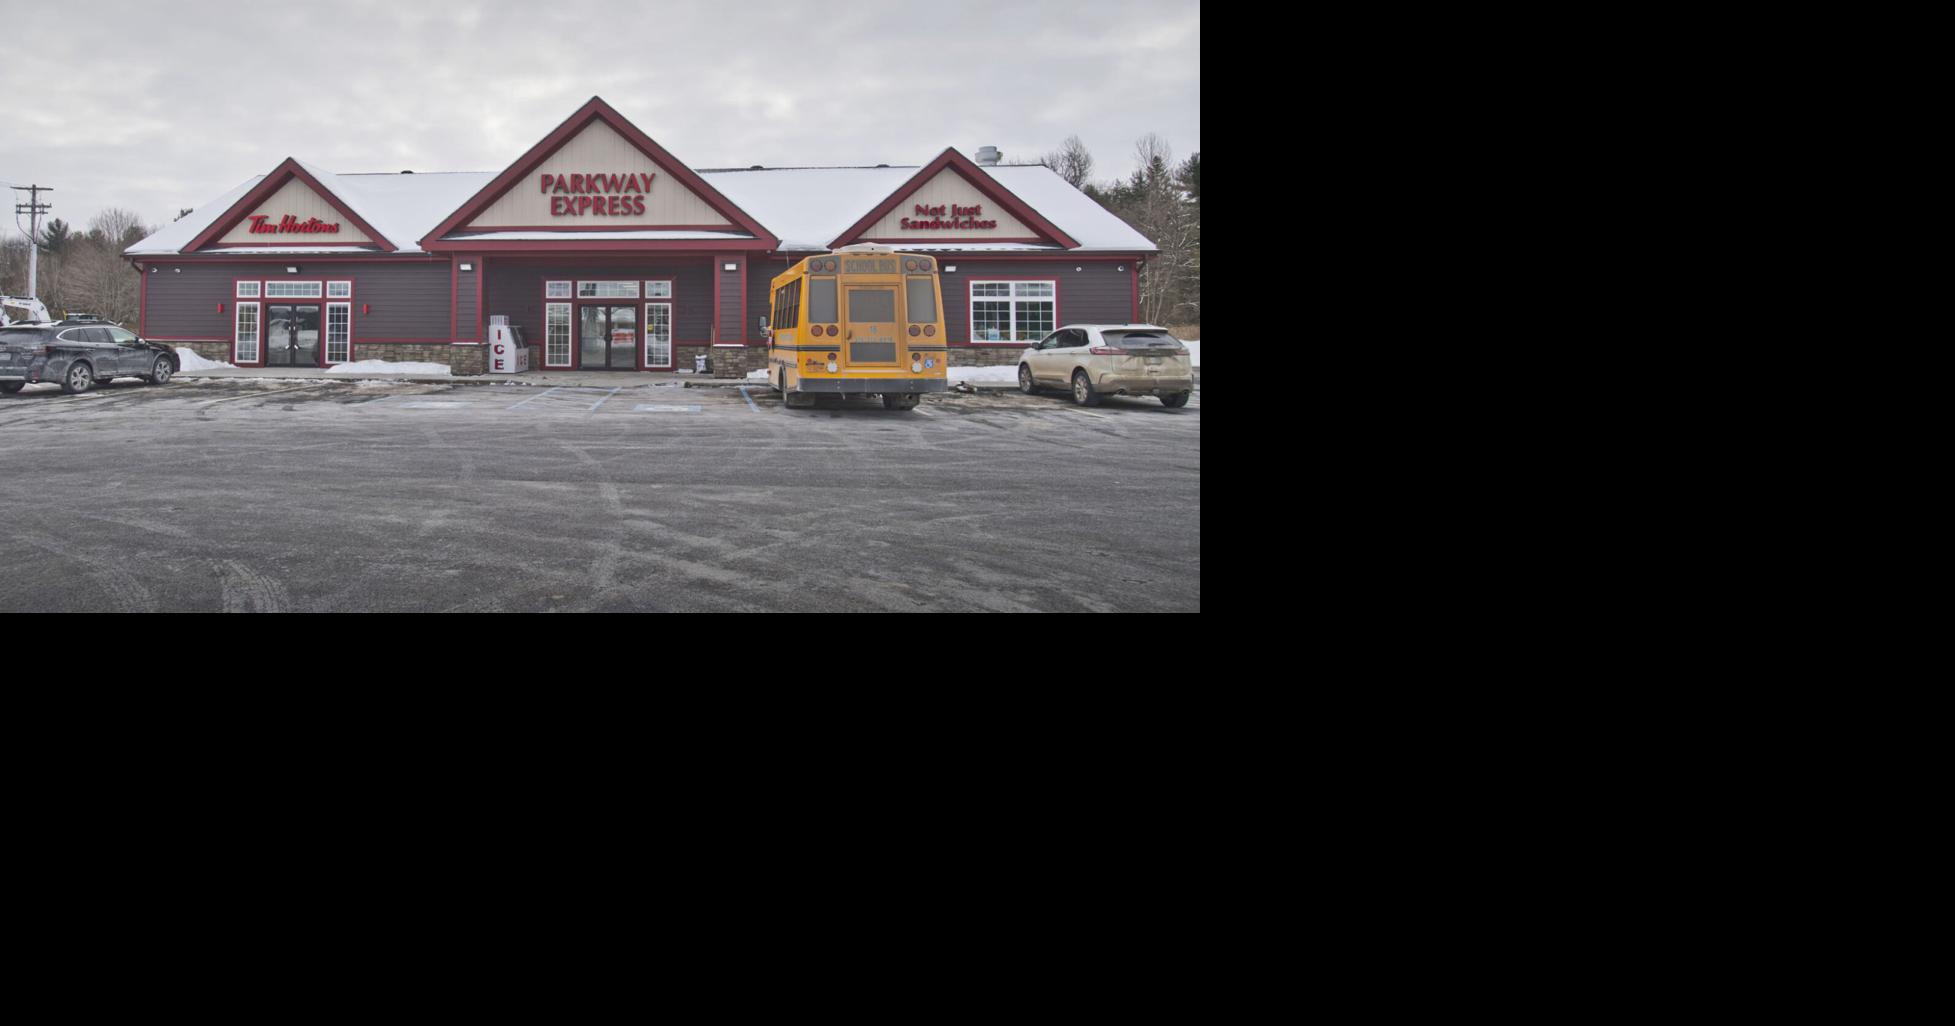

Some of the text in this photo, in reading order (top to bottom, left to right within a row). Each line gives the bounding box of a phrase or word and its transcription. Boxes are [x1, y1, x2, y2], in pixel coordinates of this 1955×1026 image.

[540, 172, 656, 194] PARKWAY
[550, 195, 646, 216] EXPRESS
[915, 203, 946, 216] Not
[248, 214, 340, 234] Tim Hortons
[900, 217, 997, 230] Sandwiches
[845, 259, 896, 273] SCHOOL BUS
[493, 329, 505, 370] ICE
